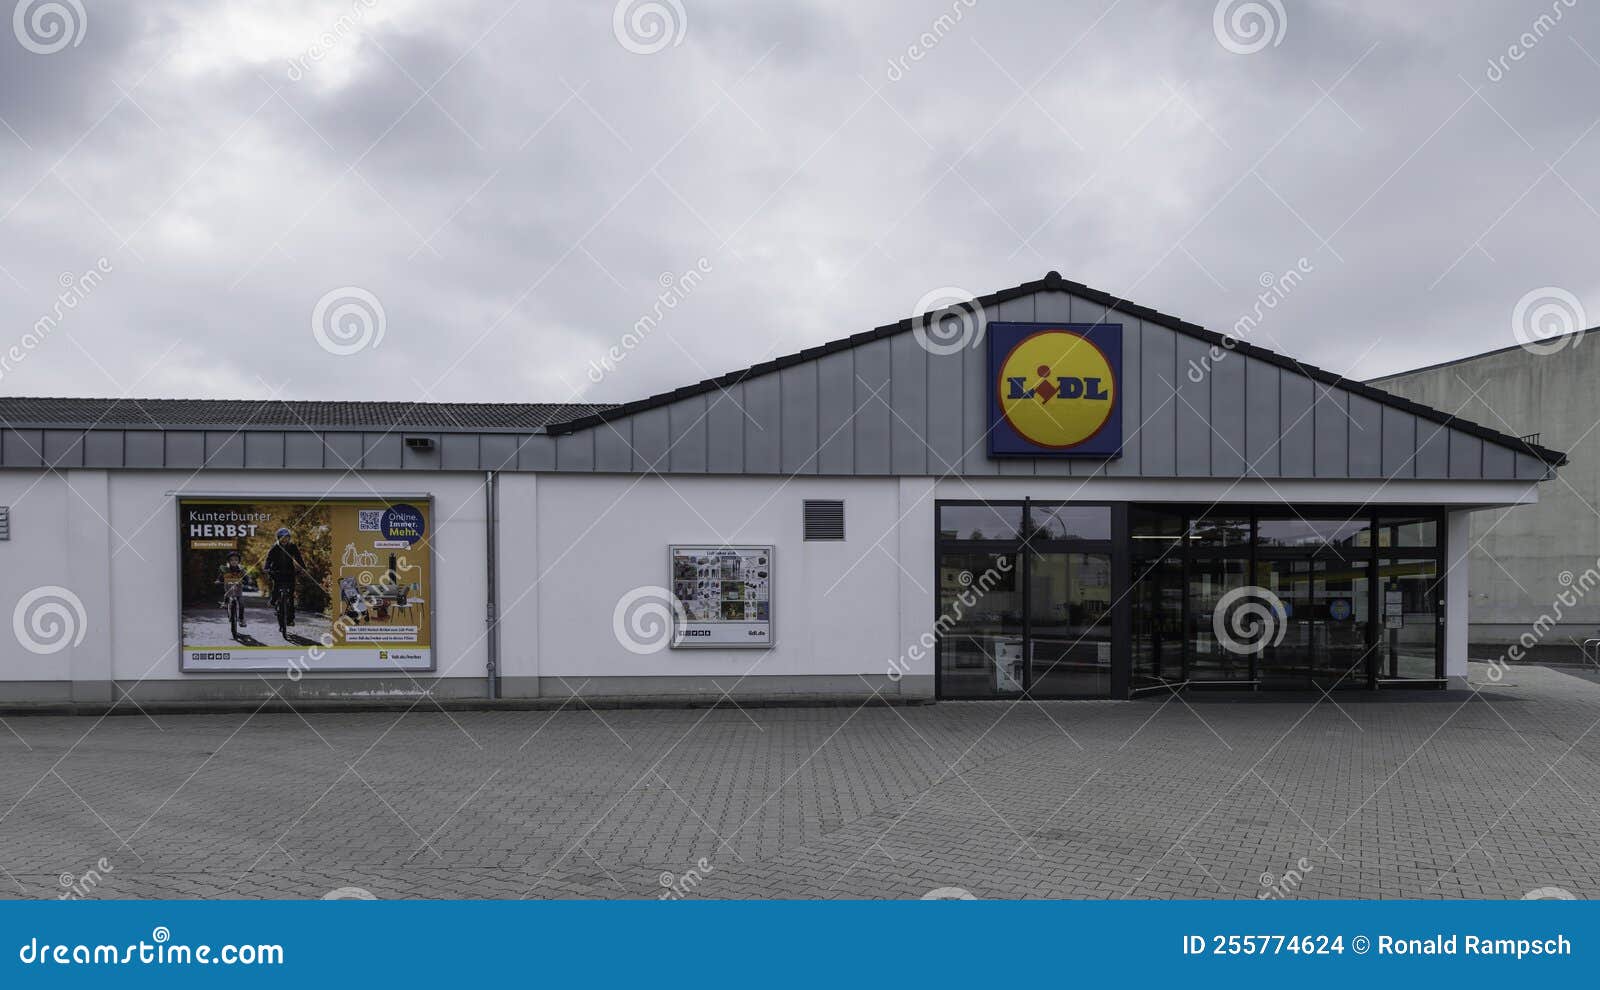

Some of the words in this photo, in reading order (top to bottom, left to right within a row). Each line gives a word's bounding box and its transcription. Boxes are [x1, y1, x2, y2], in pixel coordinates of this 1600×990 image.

[190, 511, 272, 521] Kunterbunter
[389, 512, 418, 521] Online.
[190, 524, 258, 537] HERBST
[389, 528, 418, 537] Mehr.
